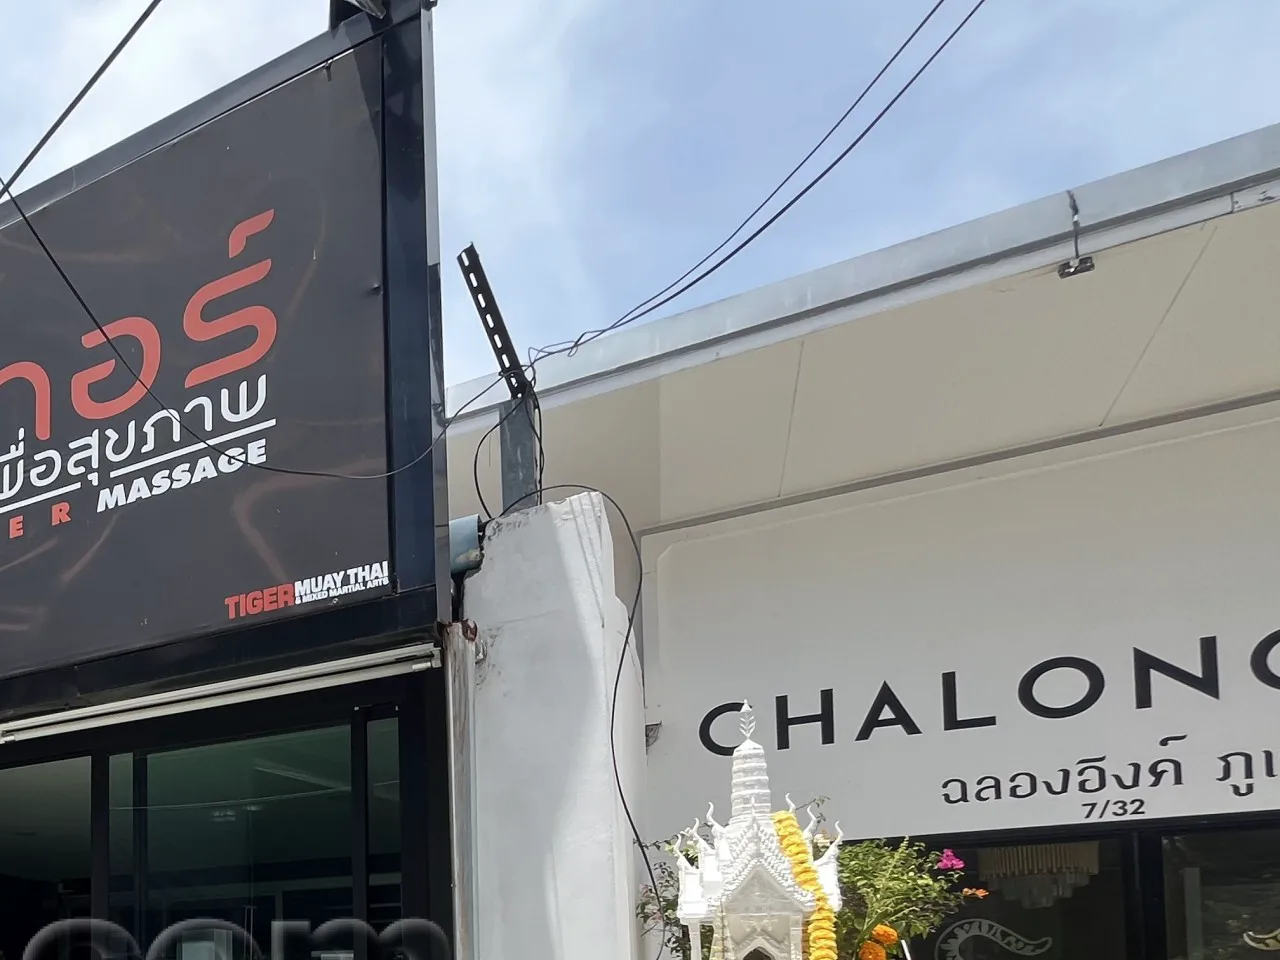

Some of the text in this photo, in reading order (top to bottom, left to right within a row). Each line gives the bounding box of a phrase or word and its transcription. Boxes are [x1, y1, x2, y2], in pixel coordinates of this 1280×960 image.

[96, 438, 267, 513] MASSAGE
[224, 560, 389, 619] TIGER MUAY THAI
[304, 589, 328, 604] MIXED
[329, 583, 366, 598] MARTIAL
[366, 576, 389, 589] ARTS
[941, 734, 1188, 805] ฉลองอิงค์
[1082, 798, 1146, 820] 7/32
